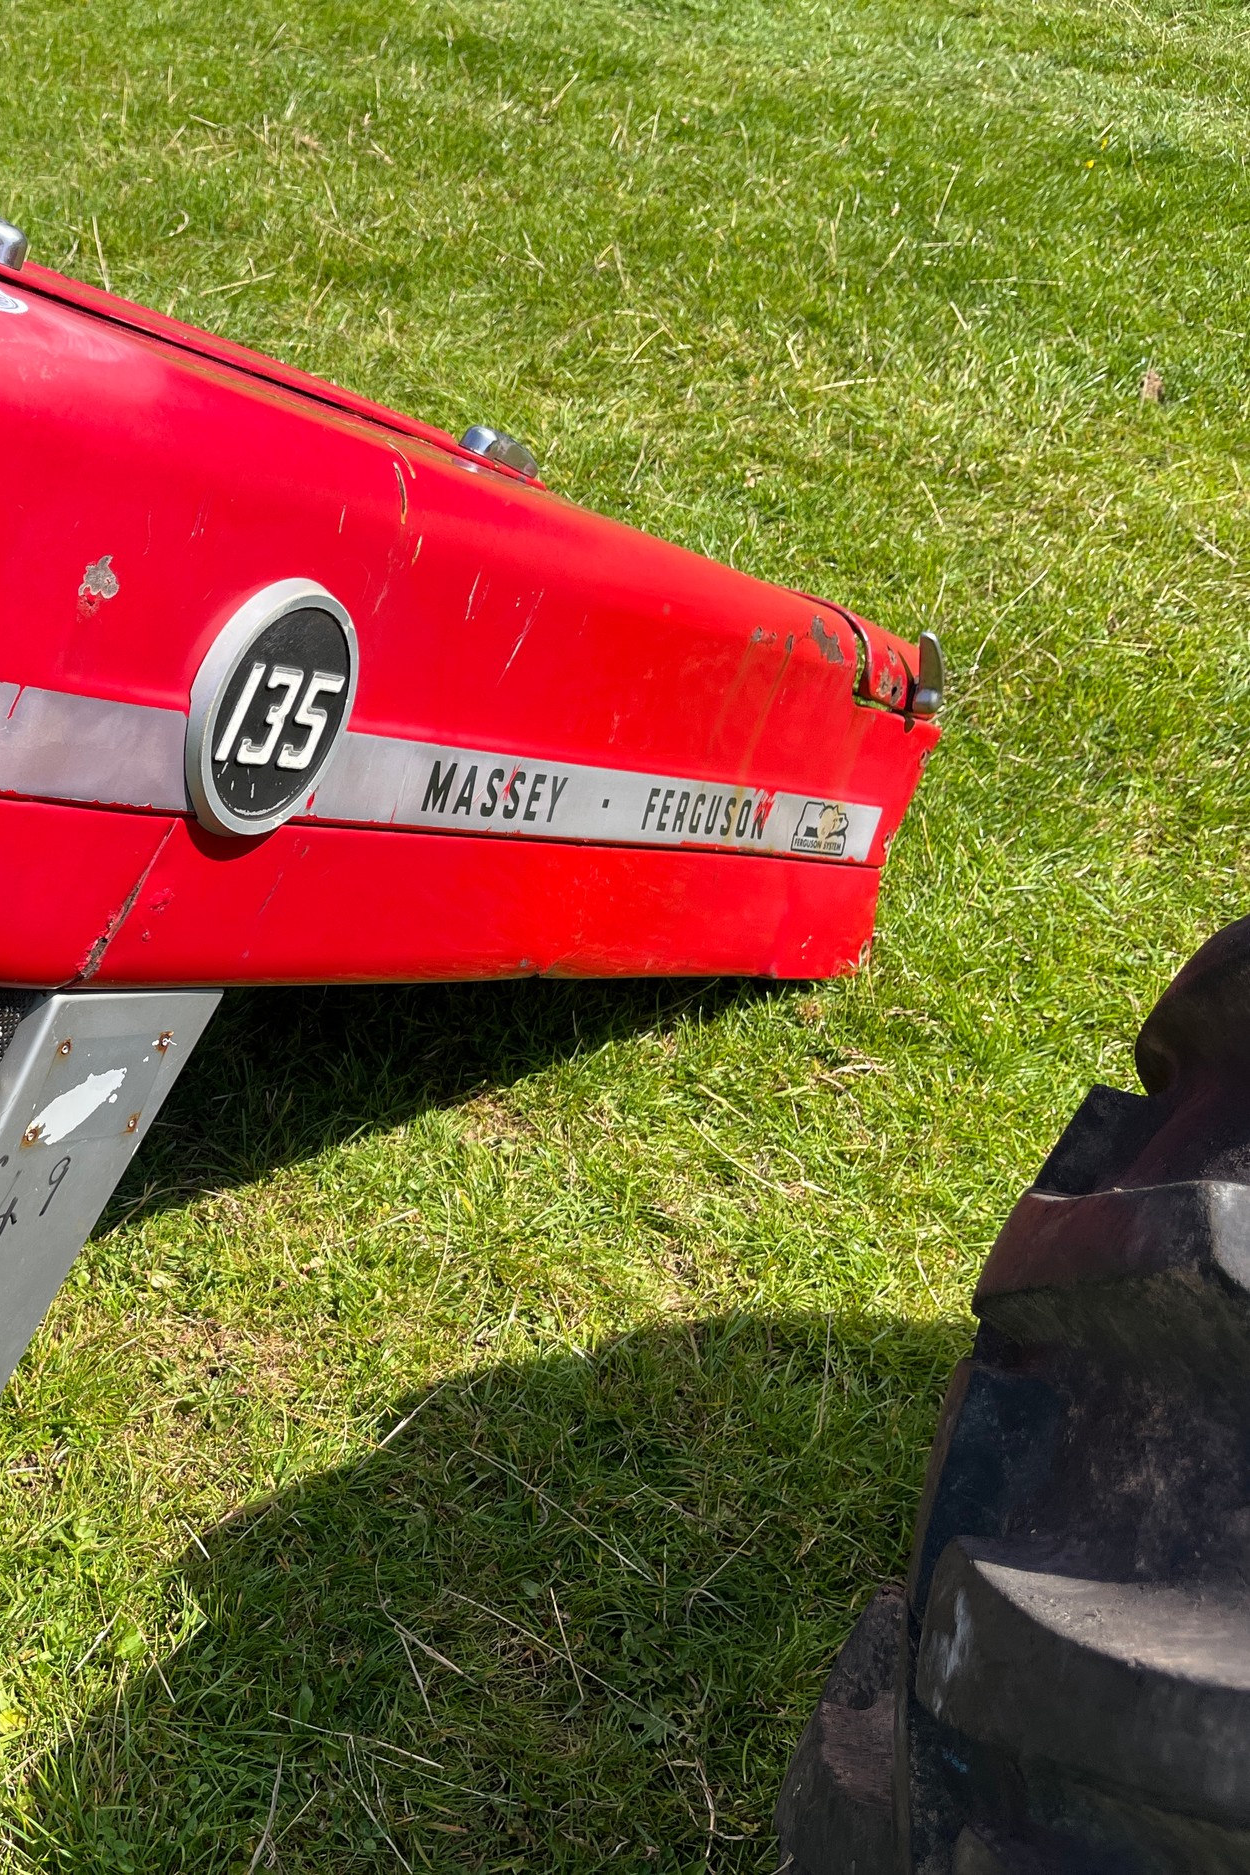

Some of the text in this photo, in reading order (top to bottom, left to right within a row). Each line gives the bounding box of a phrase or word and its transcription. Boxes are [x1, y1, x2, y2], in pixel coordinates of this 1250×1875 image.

[213, 662, 346, 770] 135
[420, 760, 569, 823] MASSEY
[793, 837, 822, 850] FERGUSON
